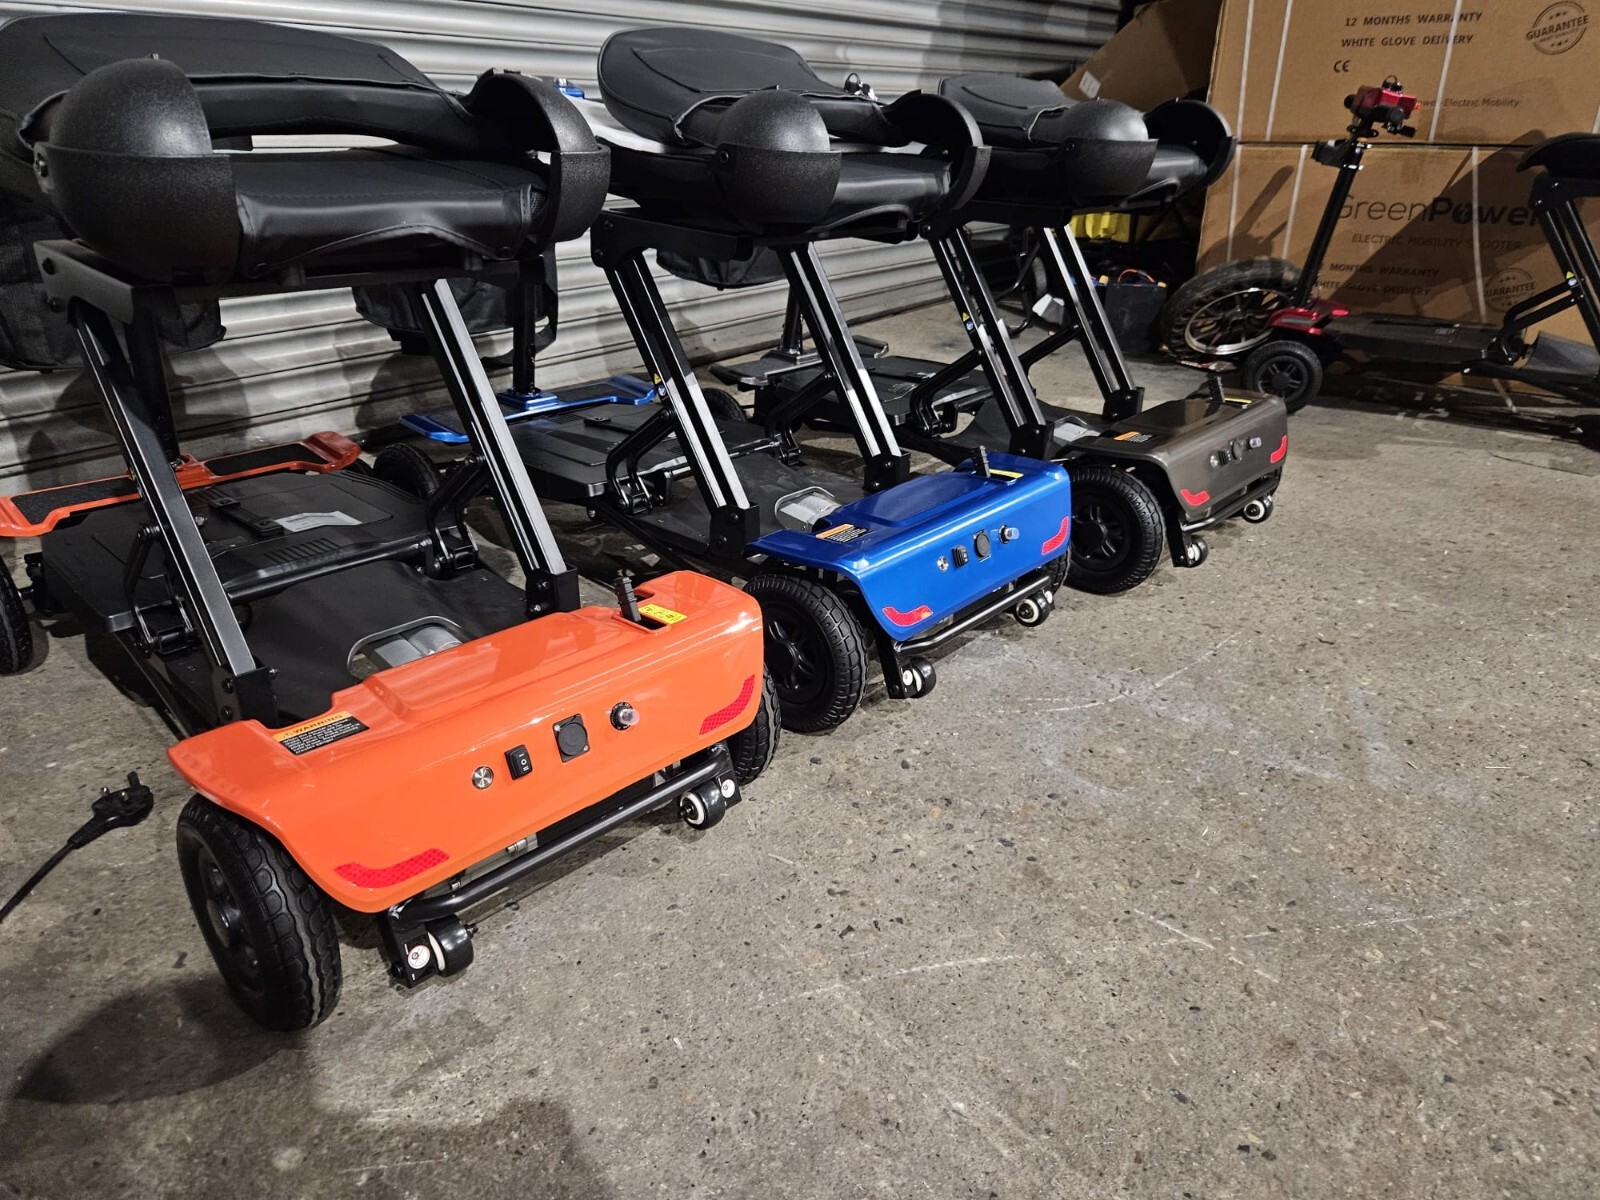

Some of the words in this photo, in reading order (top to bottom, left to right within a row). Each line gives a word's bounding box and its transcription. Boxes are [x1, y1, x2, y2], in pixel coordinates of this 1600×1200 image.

[1344, 17, 1357, 27] 12
[1363, 14, 1411, 26] MONTHS
[1526, 14, 1589, 41] GUARANTEE
[1341, 37, 1375, 47] WHITE
[1381, 35, 1417, 46] GLOVE
[1466, 239, 1521, 250] SOOTER
[1484, 281, 1537, 297] UARANTEE
